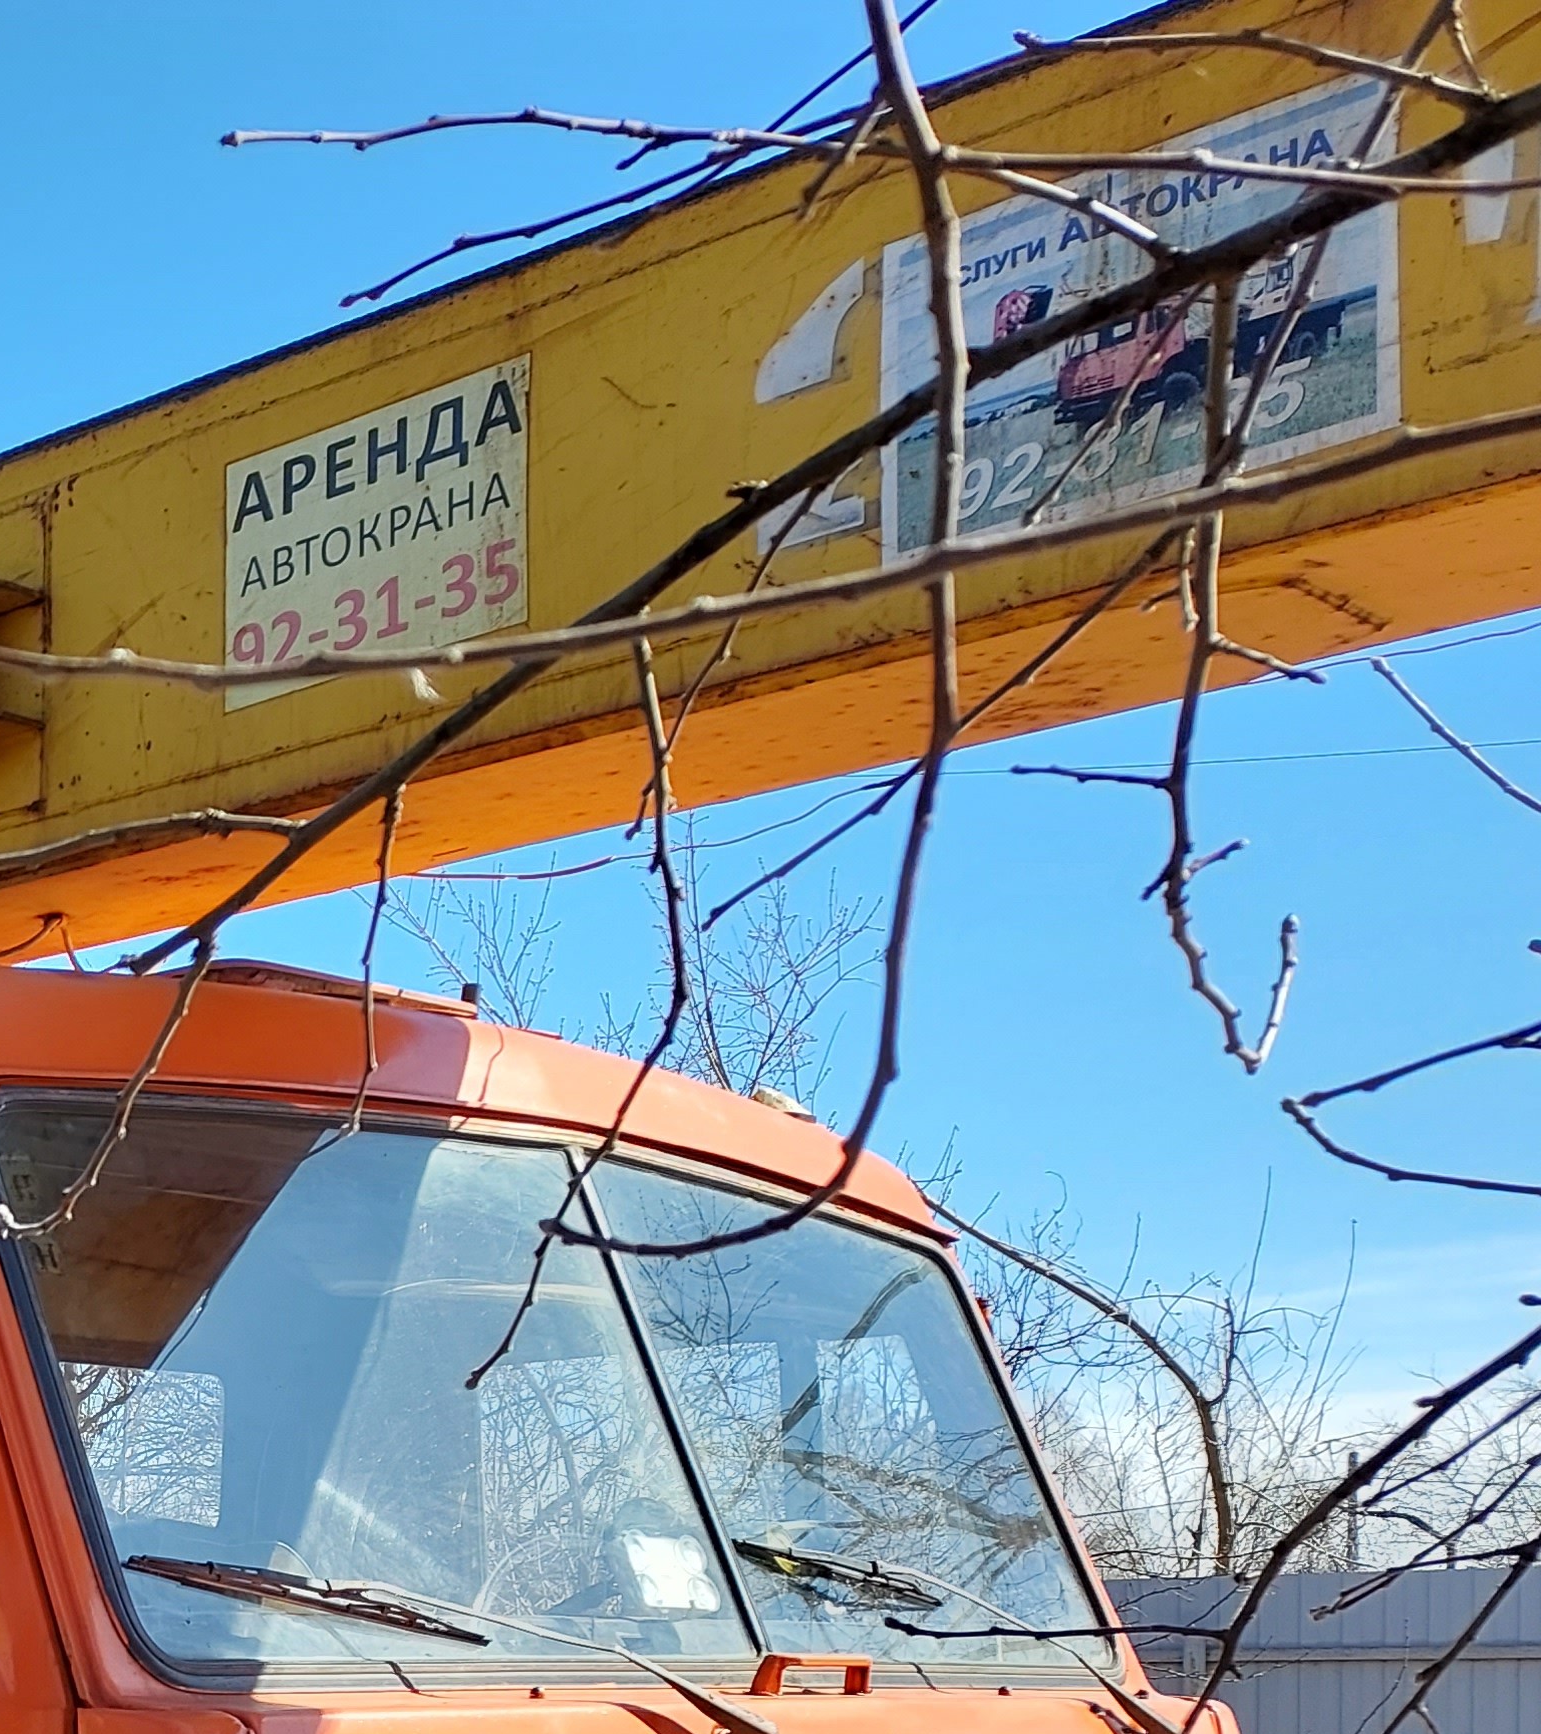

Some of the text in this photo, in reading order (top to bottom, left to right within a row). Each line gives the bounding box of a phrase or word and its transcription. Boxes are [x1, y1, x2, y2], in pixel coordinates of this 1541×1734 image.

[955, 236, 1046, 289] СЛУГИ
[232, 379, 523, 533] АРЕНДА
[240, 472, 511, 597] АВТОКРАНА
[231, 538, 520, 666] 92-31-35
